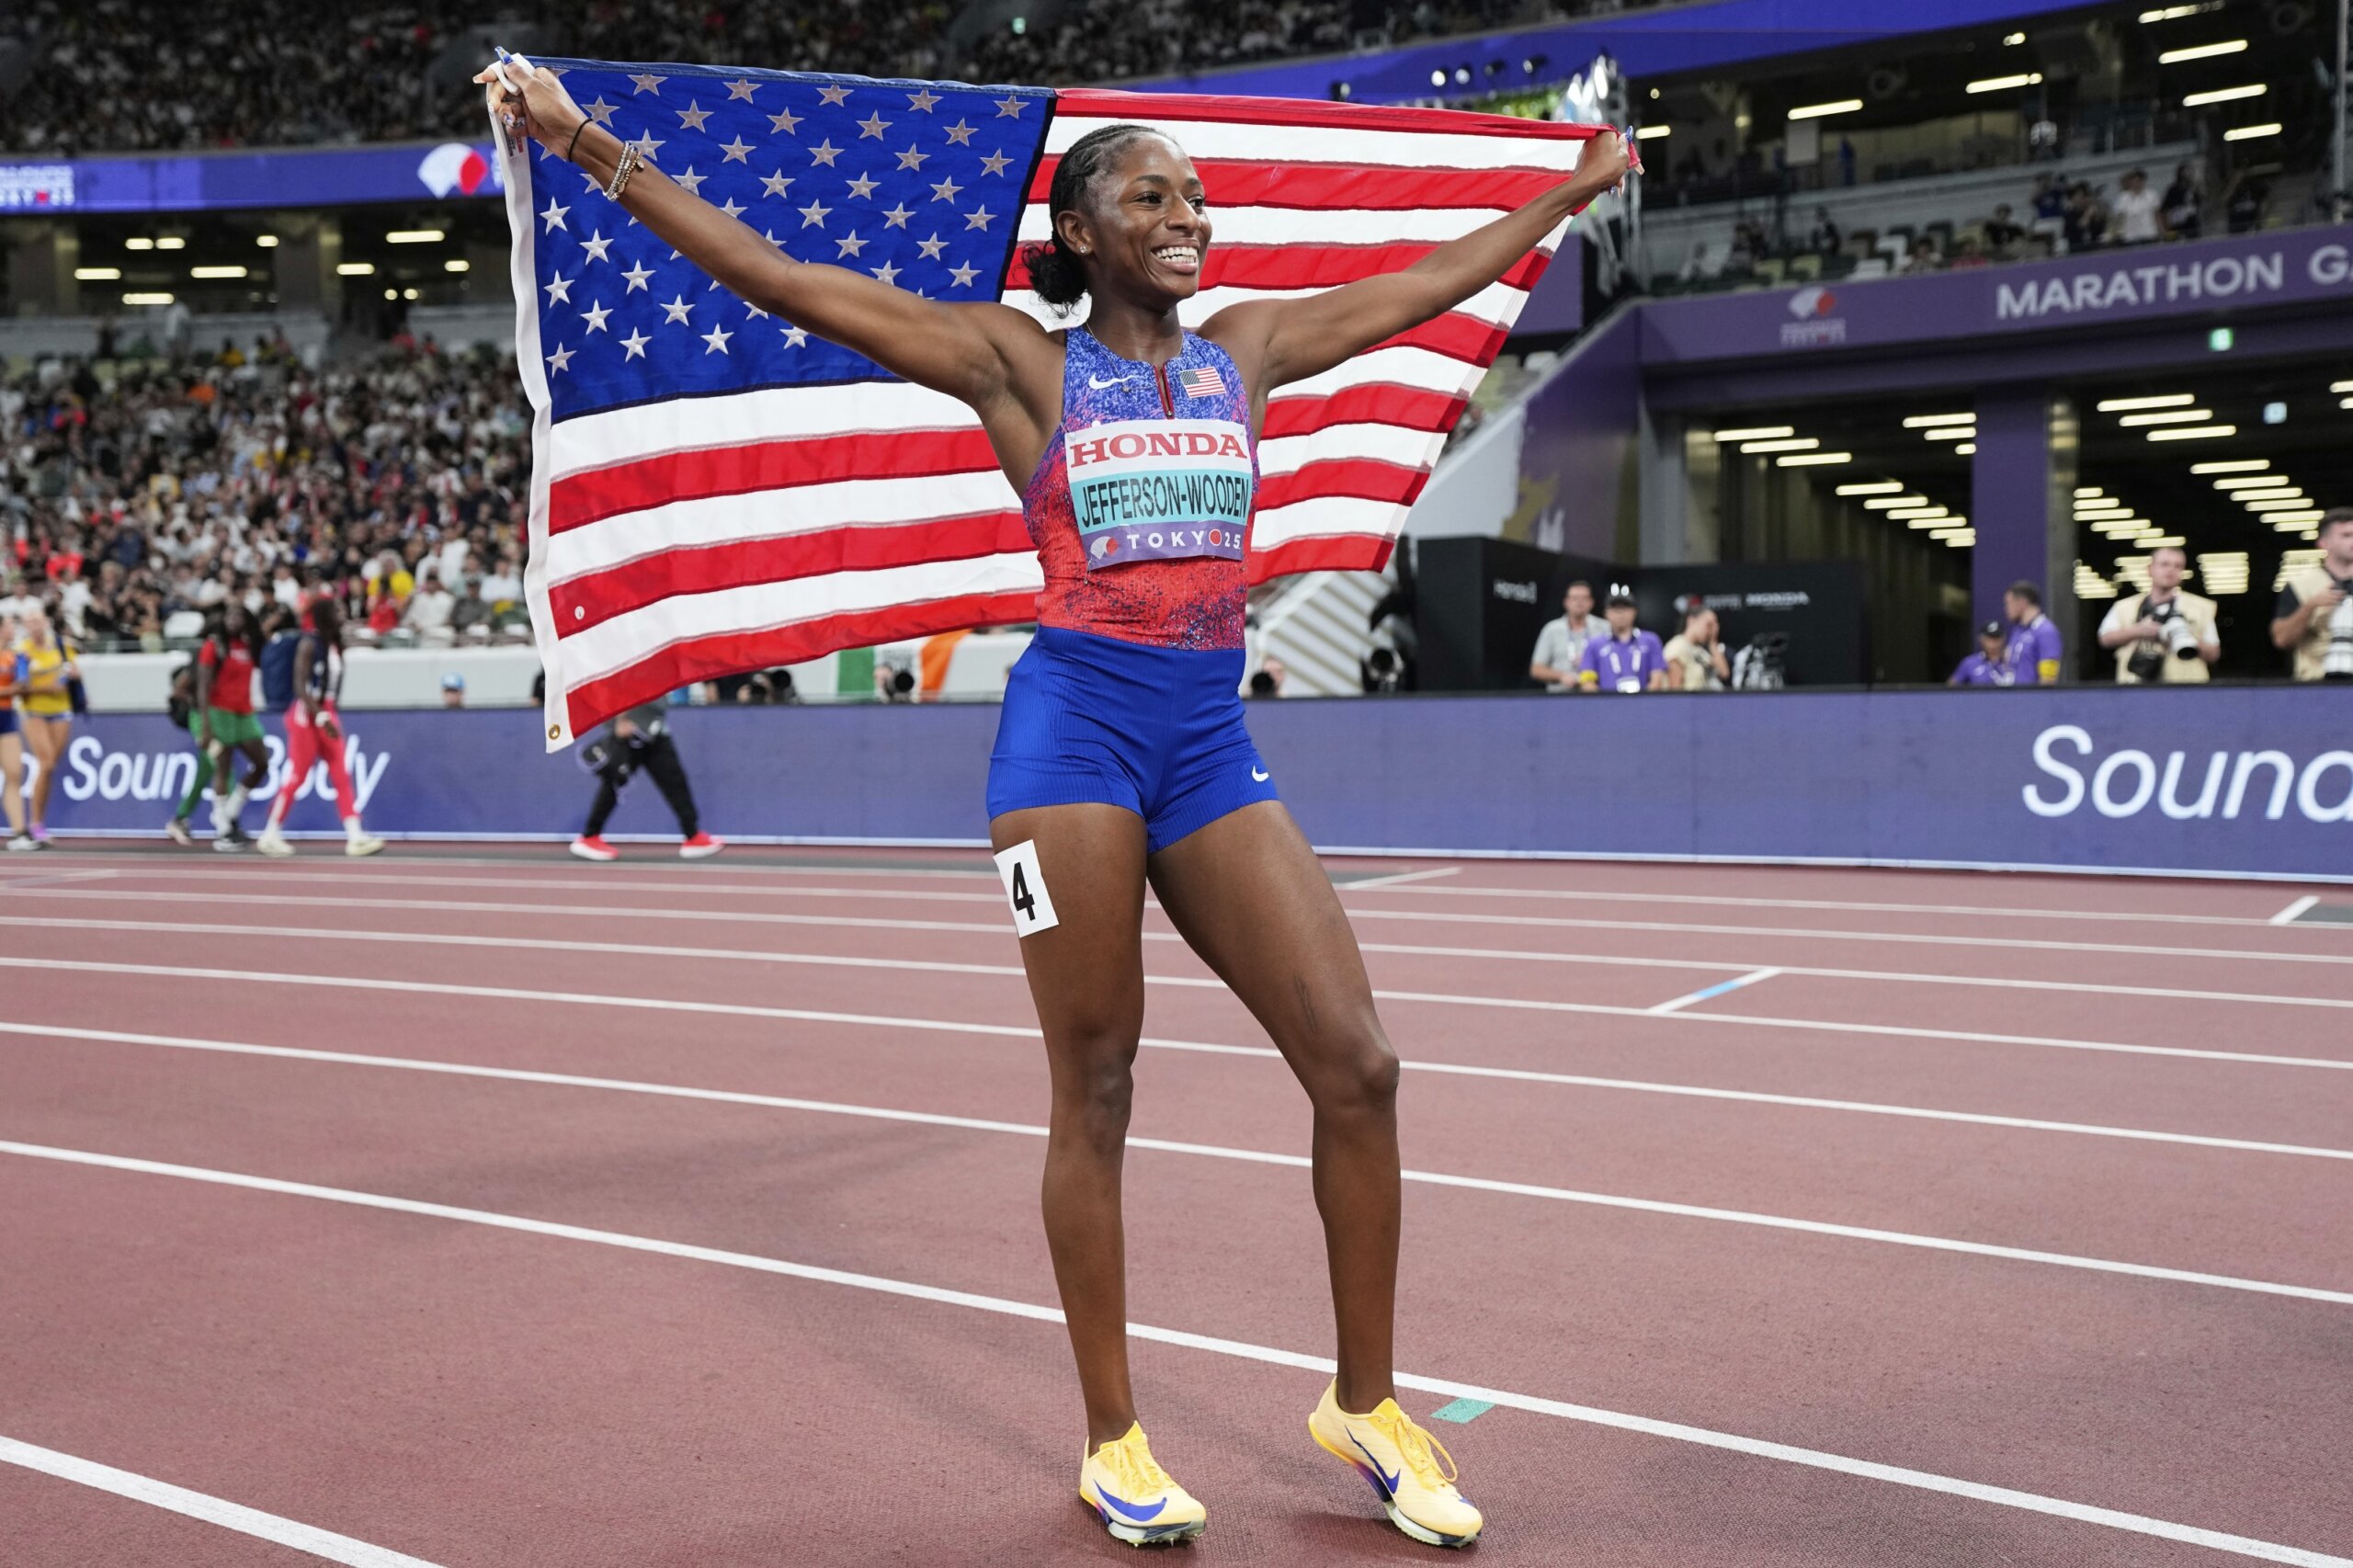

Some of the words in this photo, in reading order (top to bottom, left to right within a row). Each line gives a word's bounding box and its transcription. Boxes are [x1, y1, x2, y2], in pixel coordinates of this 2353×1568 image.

[1996, 252, 2283, 320] MARATHON
[2308, 244, 2353, 286] G
[1070, 433, 1248, 468] HONDA
[1082, 474, 1249, 528] JEFFERSON-WOODEN
[63, 736, 215, 801] Soun
[1013, 862, 1036, 921] 4
